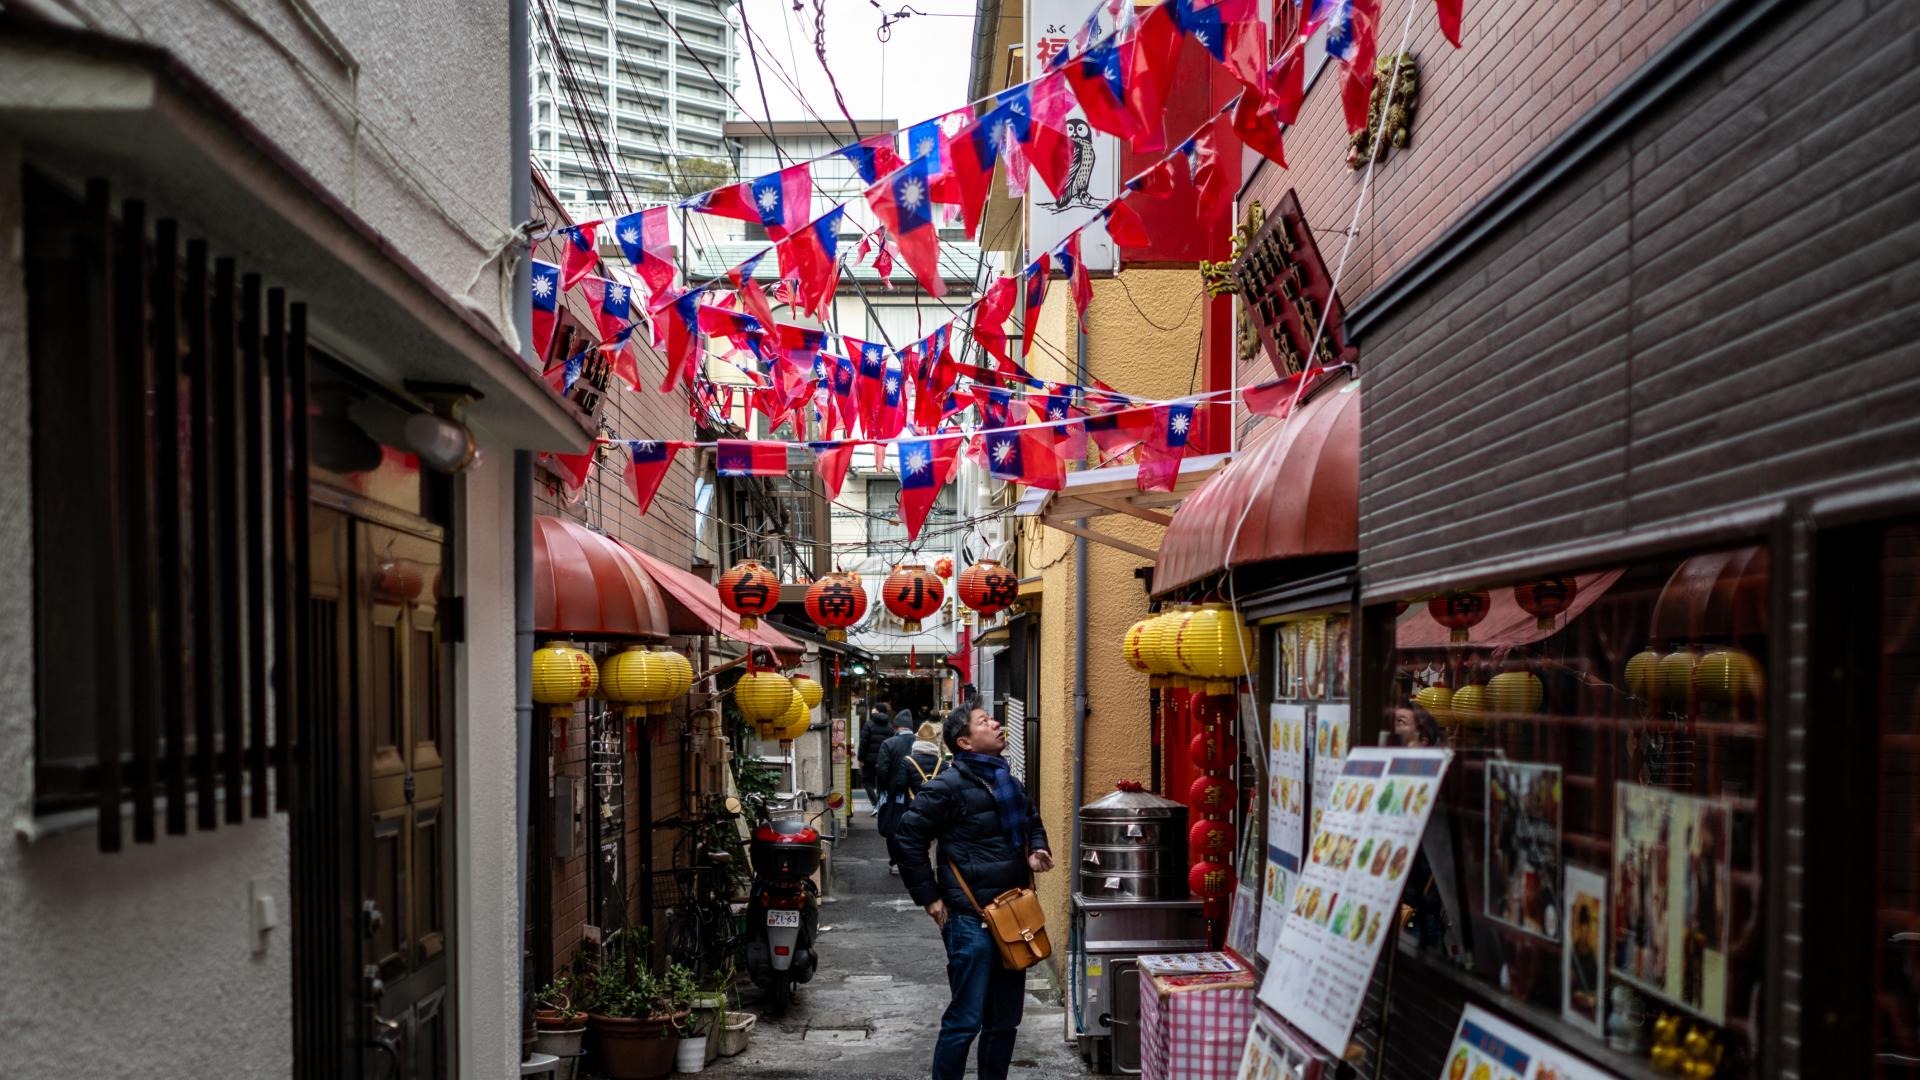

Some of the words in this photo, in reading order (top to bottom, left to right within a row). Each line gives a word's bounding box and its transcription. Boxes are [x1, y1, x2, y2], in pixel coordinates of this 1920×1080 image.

[1046, 24, 1066, 34] ふく
[733, 572, 769, 608] 台
[818, 583, 854, 618] 南
[899, 578, 938, 609] 小
[980, 574, 1018, 608] 路
